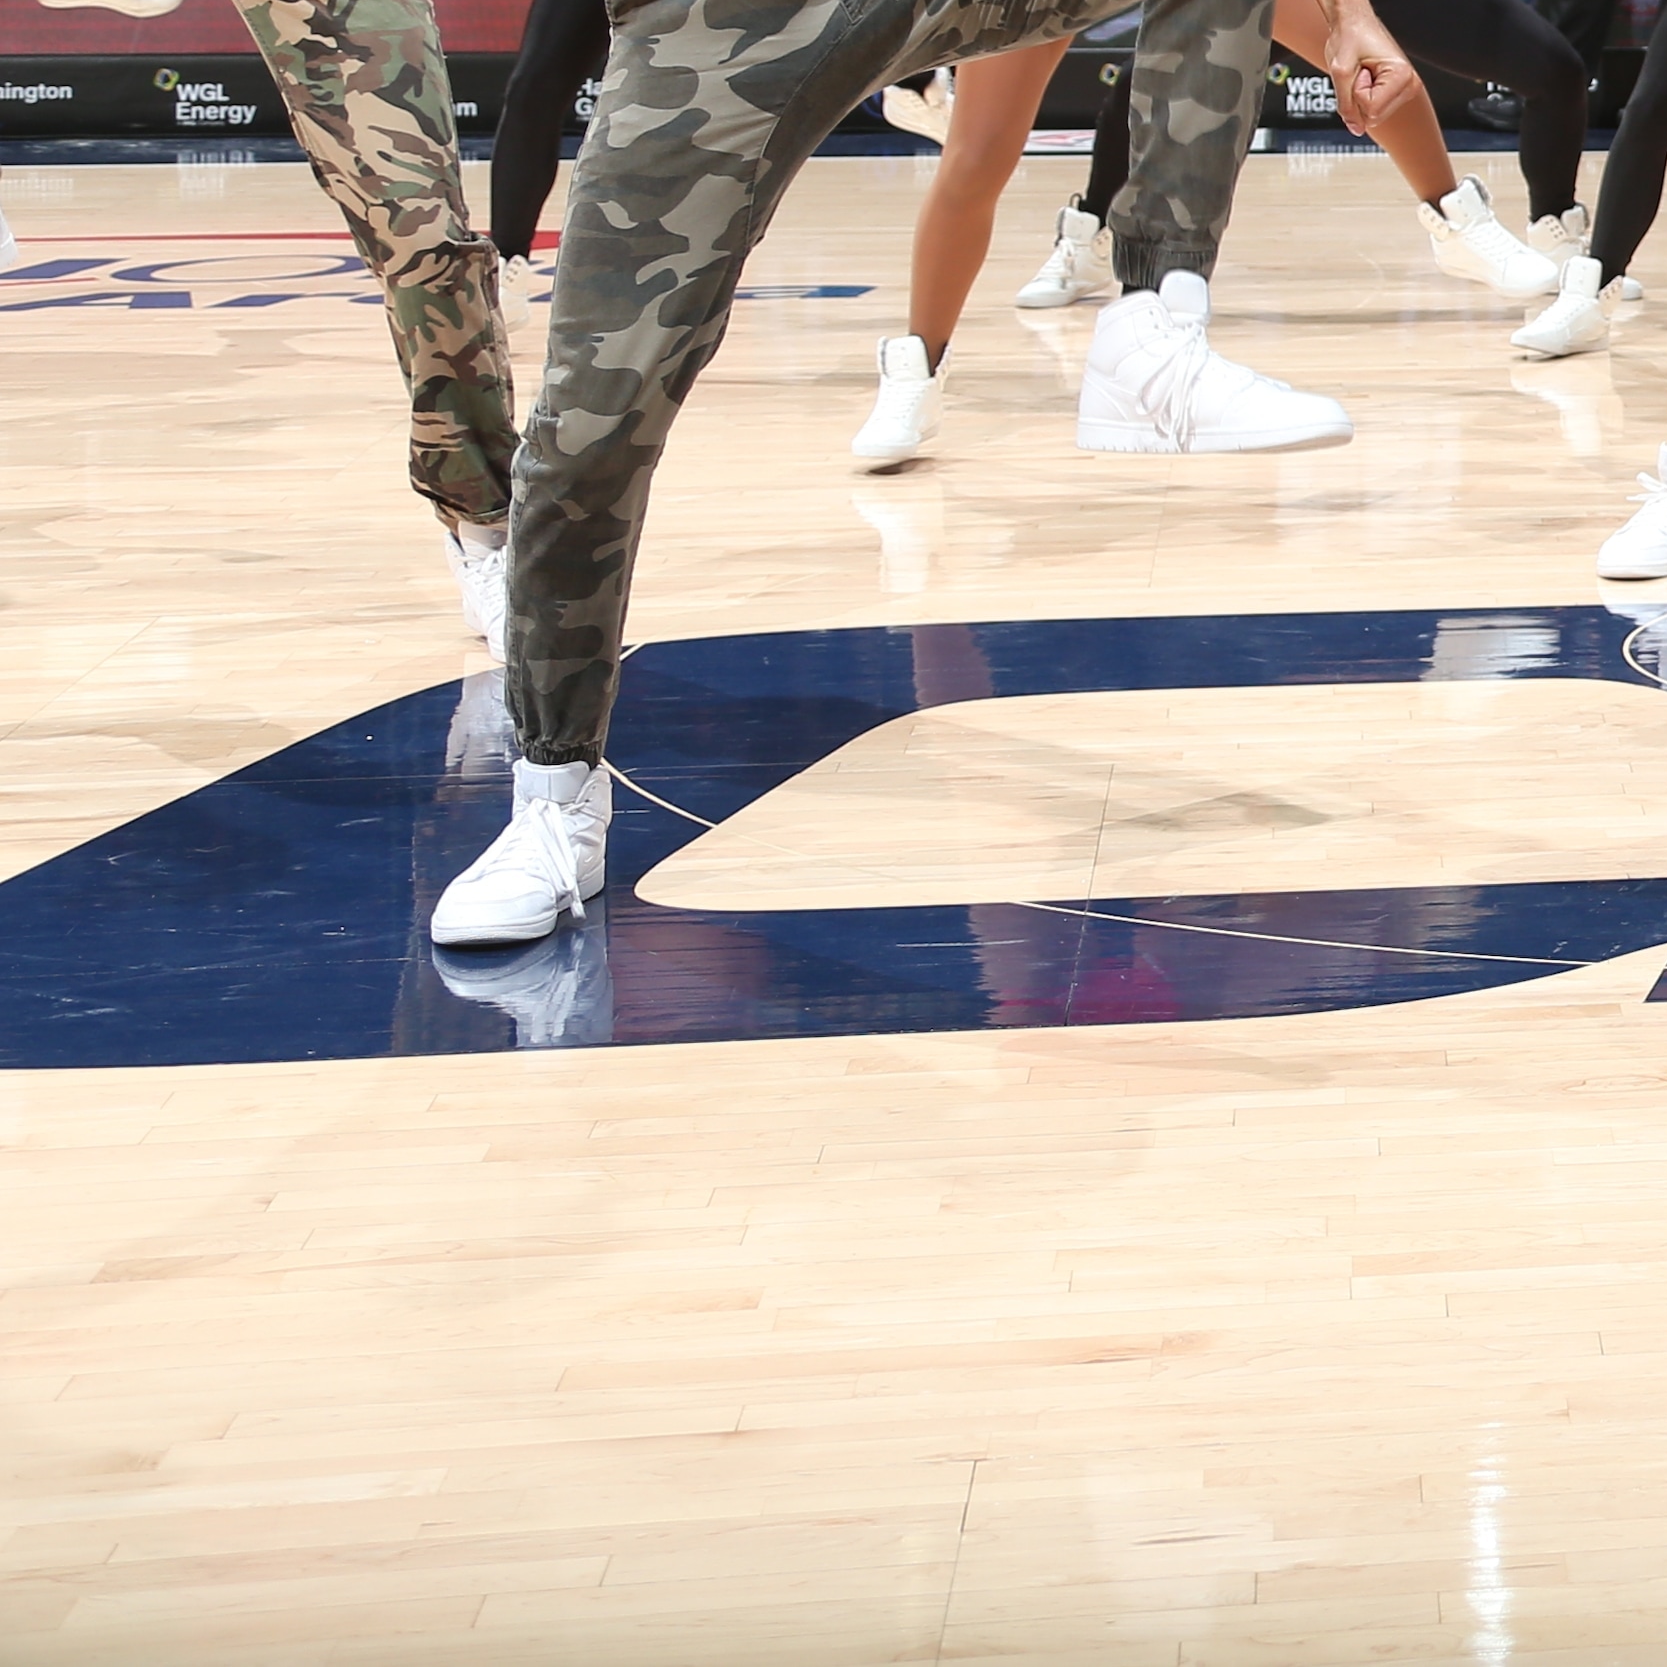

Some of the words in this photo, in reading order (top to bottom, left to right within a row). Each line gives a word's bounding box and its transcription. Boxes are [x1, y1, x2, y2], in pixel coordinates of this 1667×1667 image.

[176, 83, 230, 102] WGL
[1286, 76, 1335, 95] WGL
[176, 102, 257, 125] Energy
